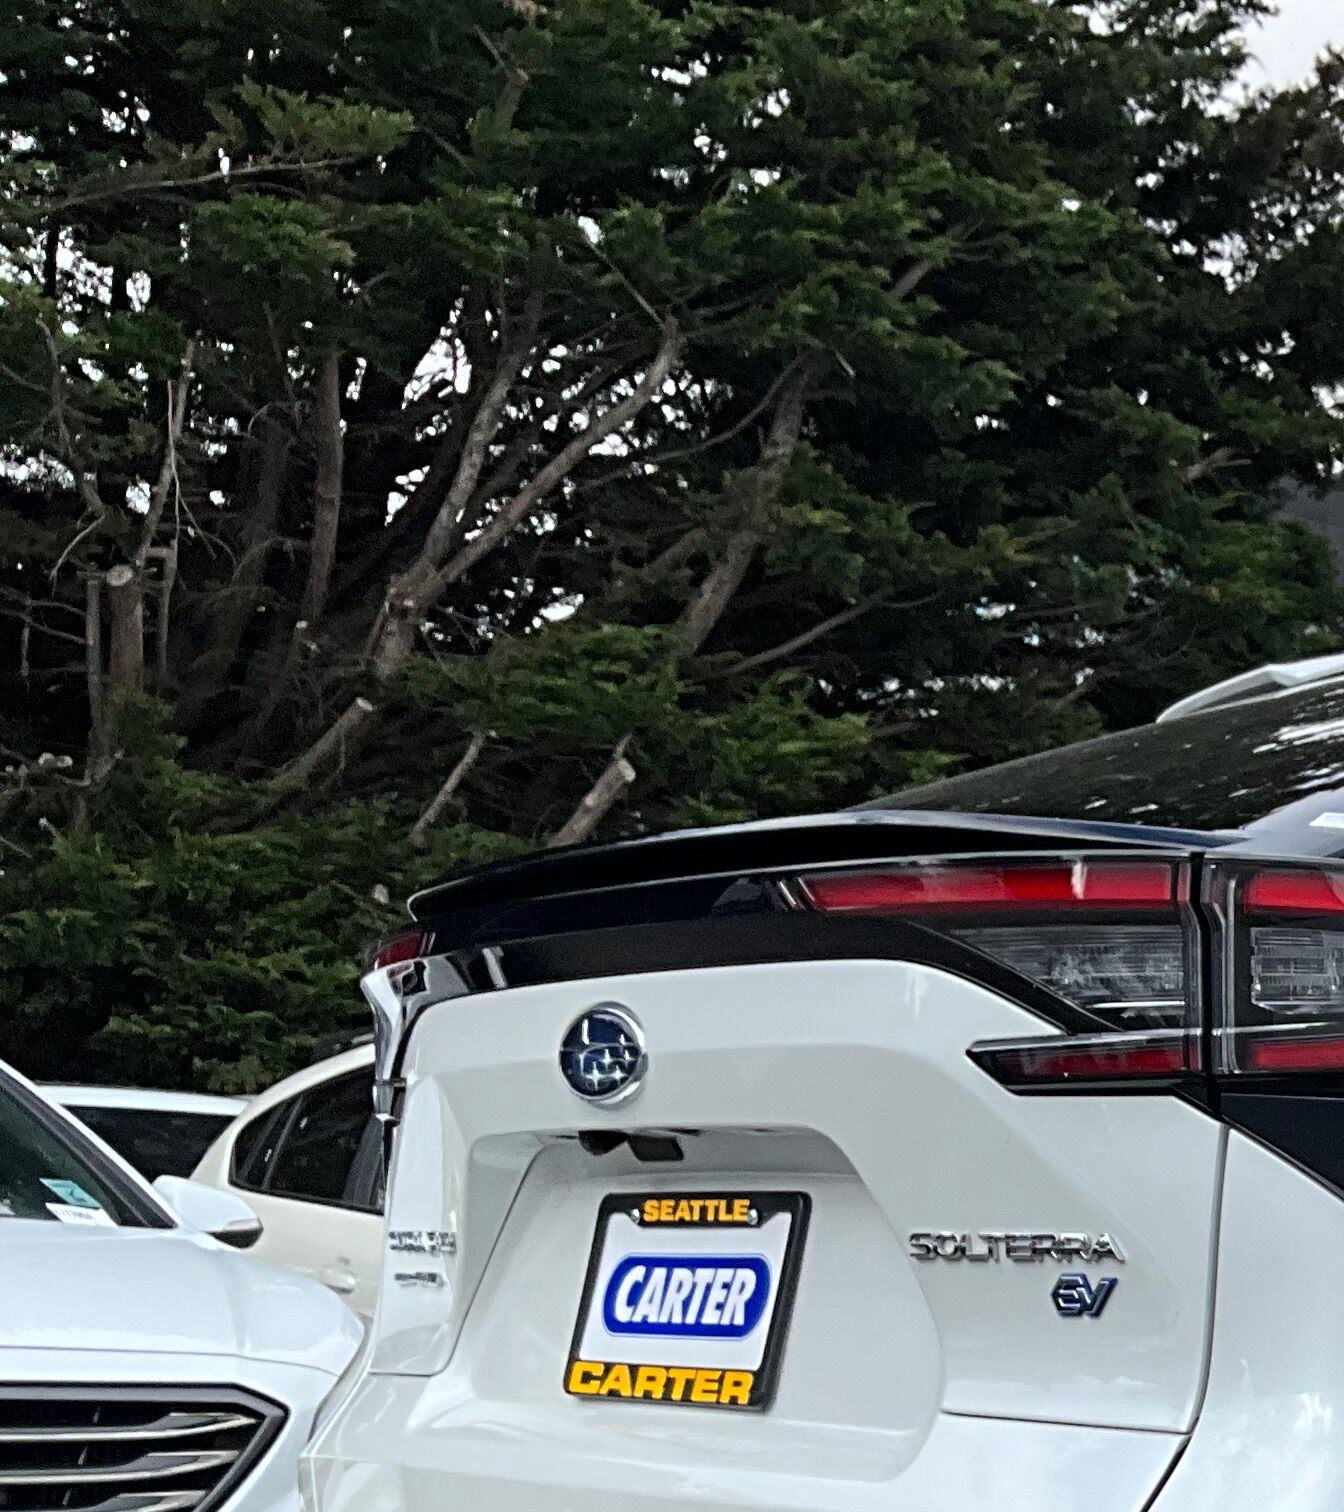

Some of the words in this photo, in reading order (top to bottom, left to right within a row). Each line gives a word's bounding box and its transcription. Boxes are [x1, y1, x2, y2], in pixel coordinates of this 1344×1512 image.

[643, 1199, 750, 1222] SEATTLE
[909, 1231, 1126, 1264] SOLTERRA
[614, 1265, 757, 1326] CARTER
[568, 1360, 754, 1406] CARTER
